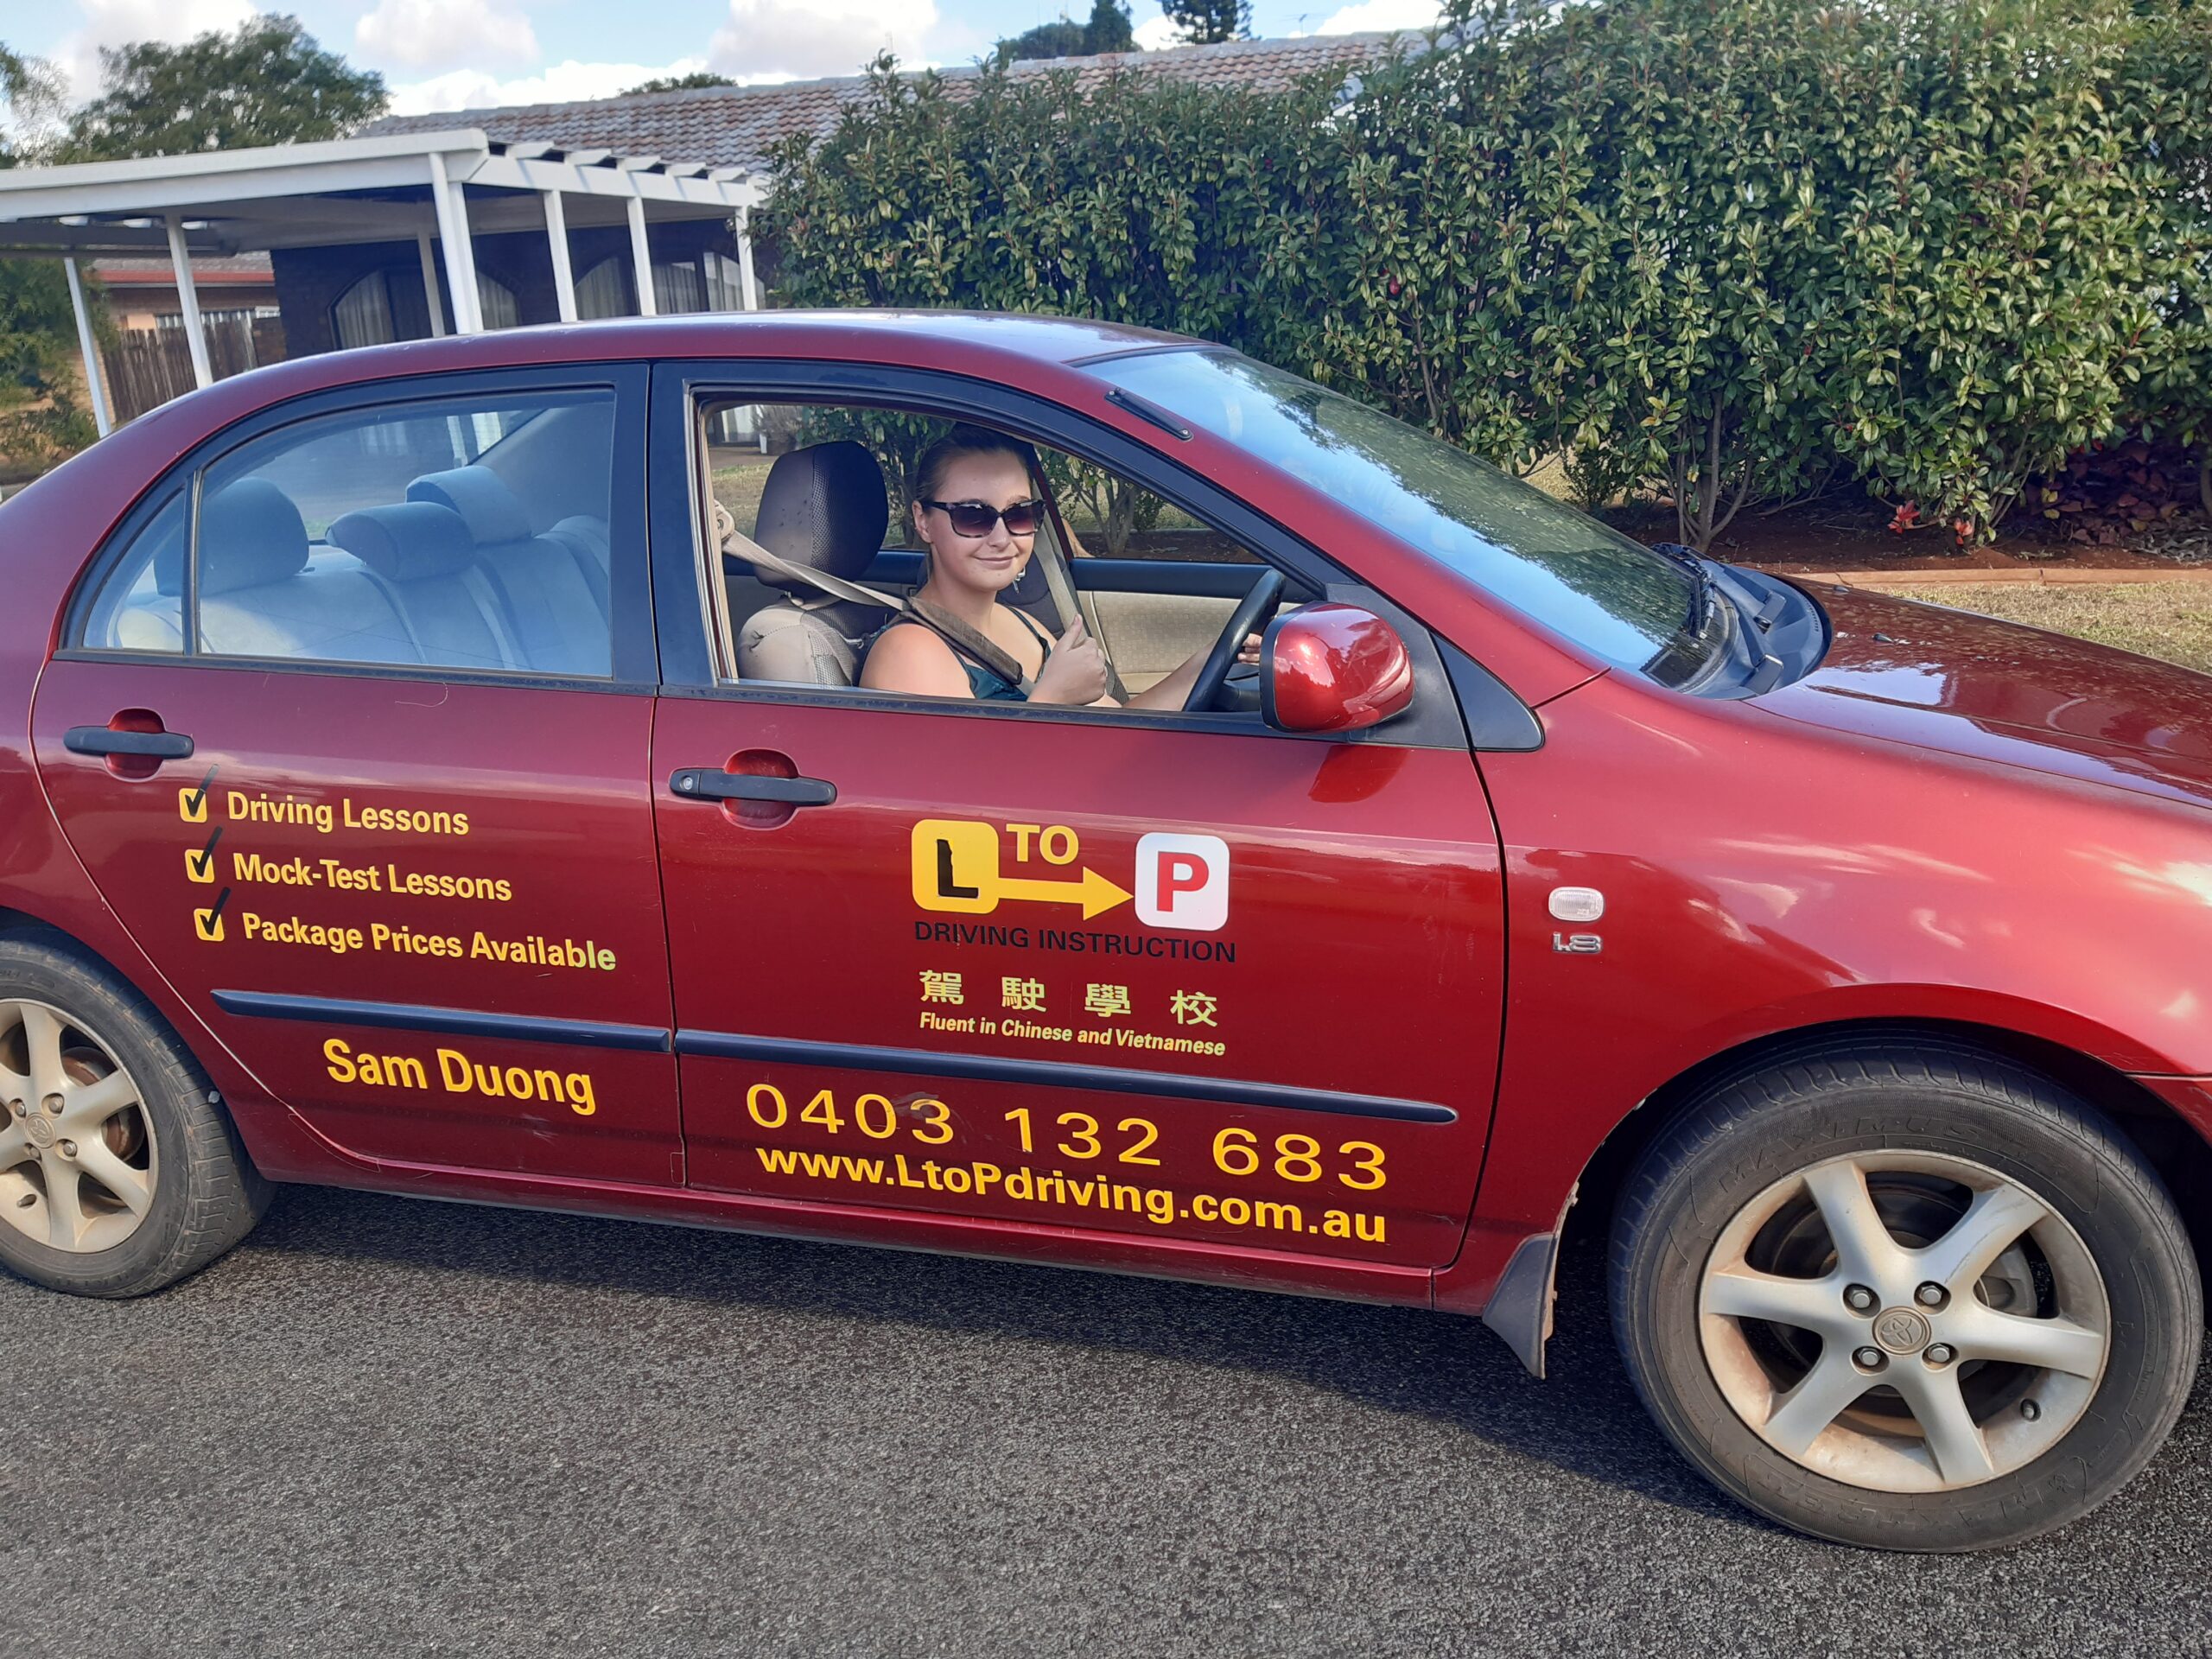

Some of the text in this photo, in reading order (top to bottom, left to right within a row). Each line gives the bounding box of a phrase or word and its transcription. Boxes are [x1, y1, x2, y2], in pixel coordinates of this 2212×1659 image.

[227, 791, 469, 836] Driving Lessons
[232, 852, 512, 902] Mock-Test Lessons
[937, 823, 1210, 912] L TO P
[242, 912, 617, 971] Package Prices Available
[914, 920, 1236, 963] DRIVING INSTRUCTION
[918, 969, 1218, 1027] 駕駛學校
[919, 1011, 1227, 1057] Fluent in Chinese and Vietnamese
[323, 1039, 596, 1116] Sam Duong
[747, 1084, 1388, 1191] 0403 132 683
[755, 1146, 1388, 1243] www.LtoPdriving.com.au
